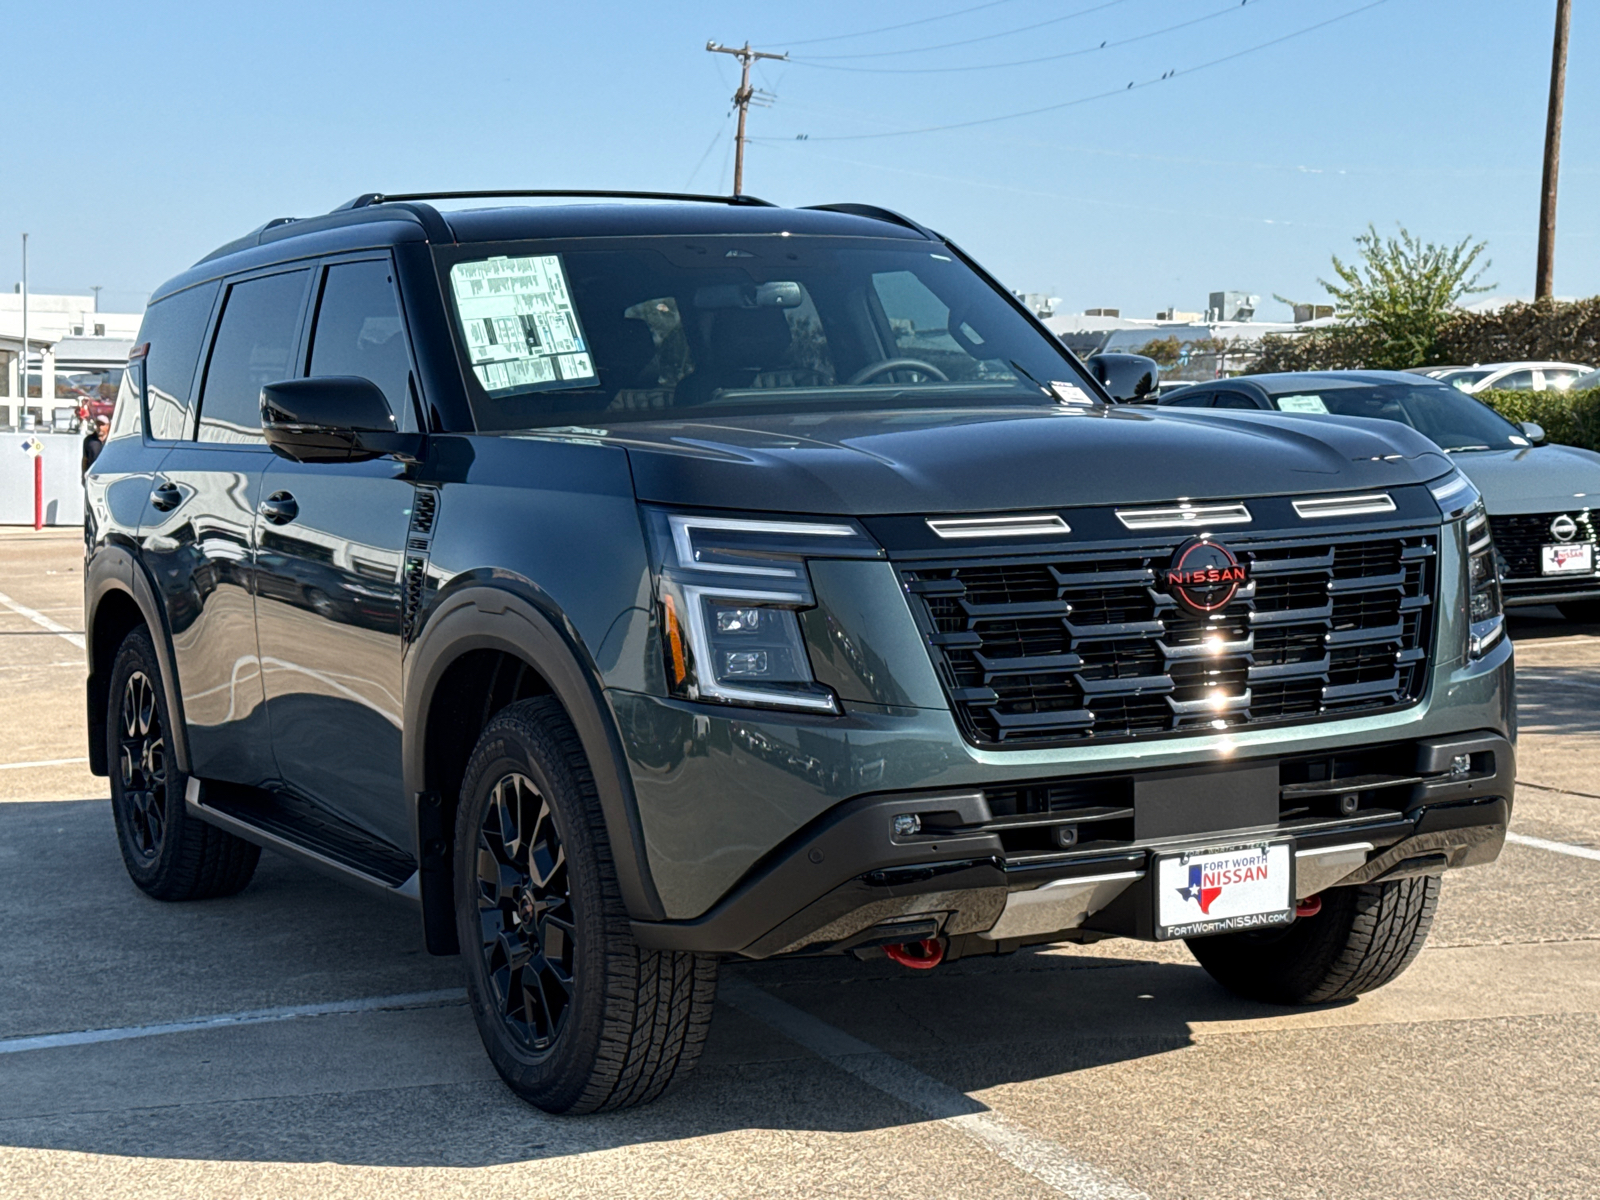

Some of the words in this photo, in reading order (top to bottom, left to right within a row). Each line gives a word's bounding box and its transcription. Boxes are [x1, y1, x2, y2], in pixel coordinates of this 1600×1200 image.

[1168, 568, 1245, 585] NISSAN
[1208, 846, 1235, 854] WORTH
[1203, 860, 1230, 872] FORT
[1232, 855, 1268, 868] WORTH
[1203, 865, 1268, 887] NISSAN
